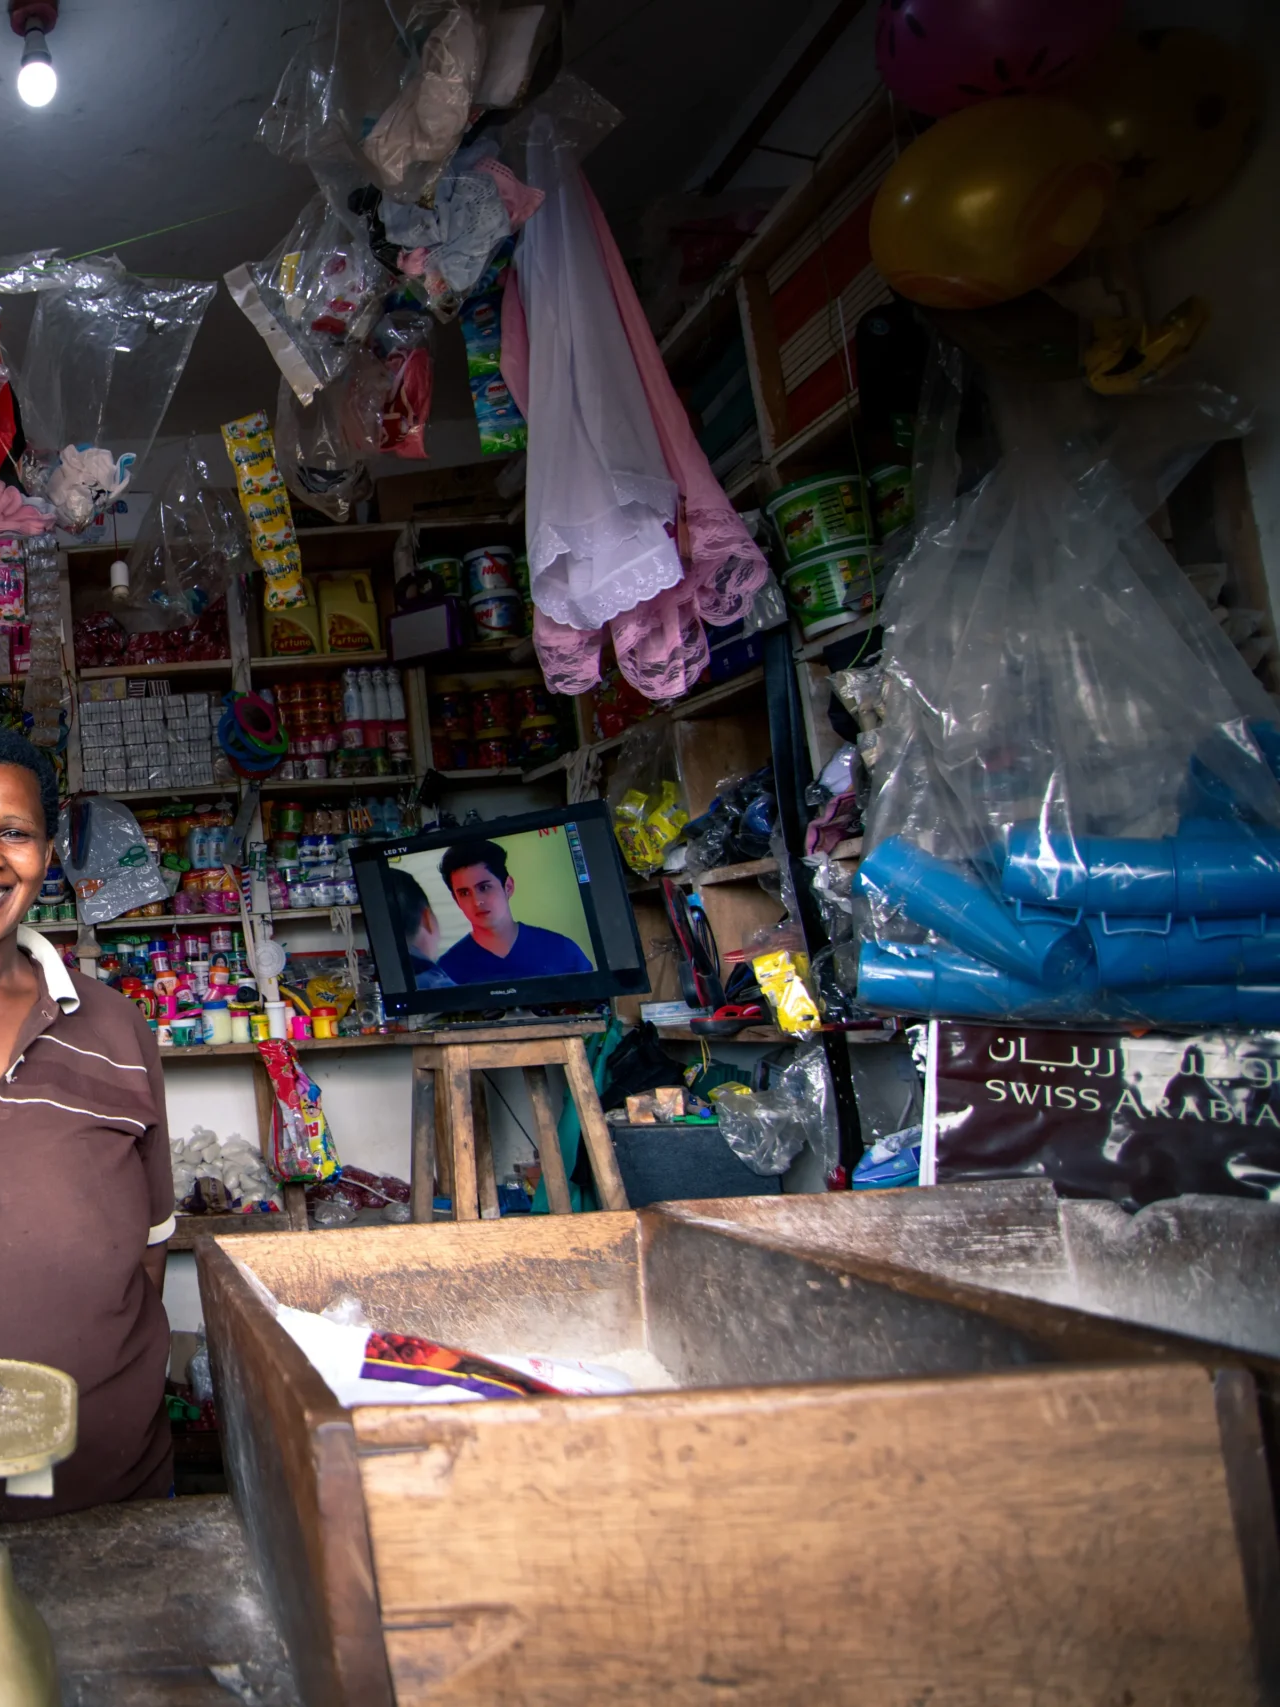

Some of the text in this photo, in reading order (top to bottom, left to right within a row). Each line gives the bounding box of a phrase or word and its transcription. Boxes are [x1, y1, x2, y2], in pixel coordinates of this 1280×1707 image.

[250, 505, 285, 520] Sunlight
[383, 846, 408, 857] LED TV
[985, 1078, 1102, 1113] SWISS
